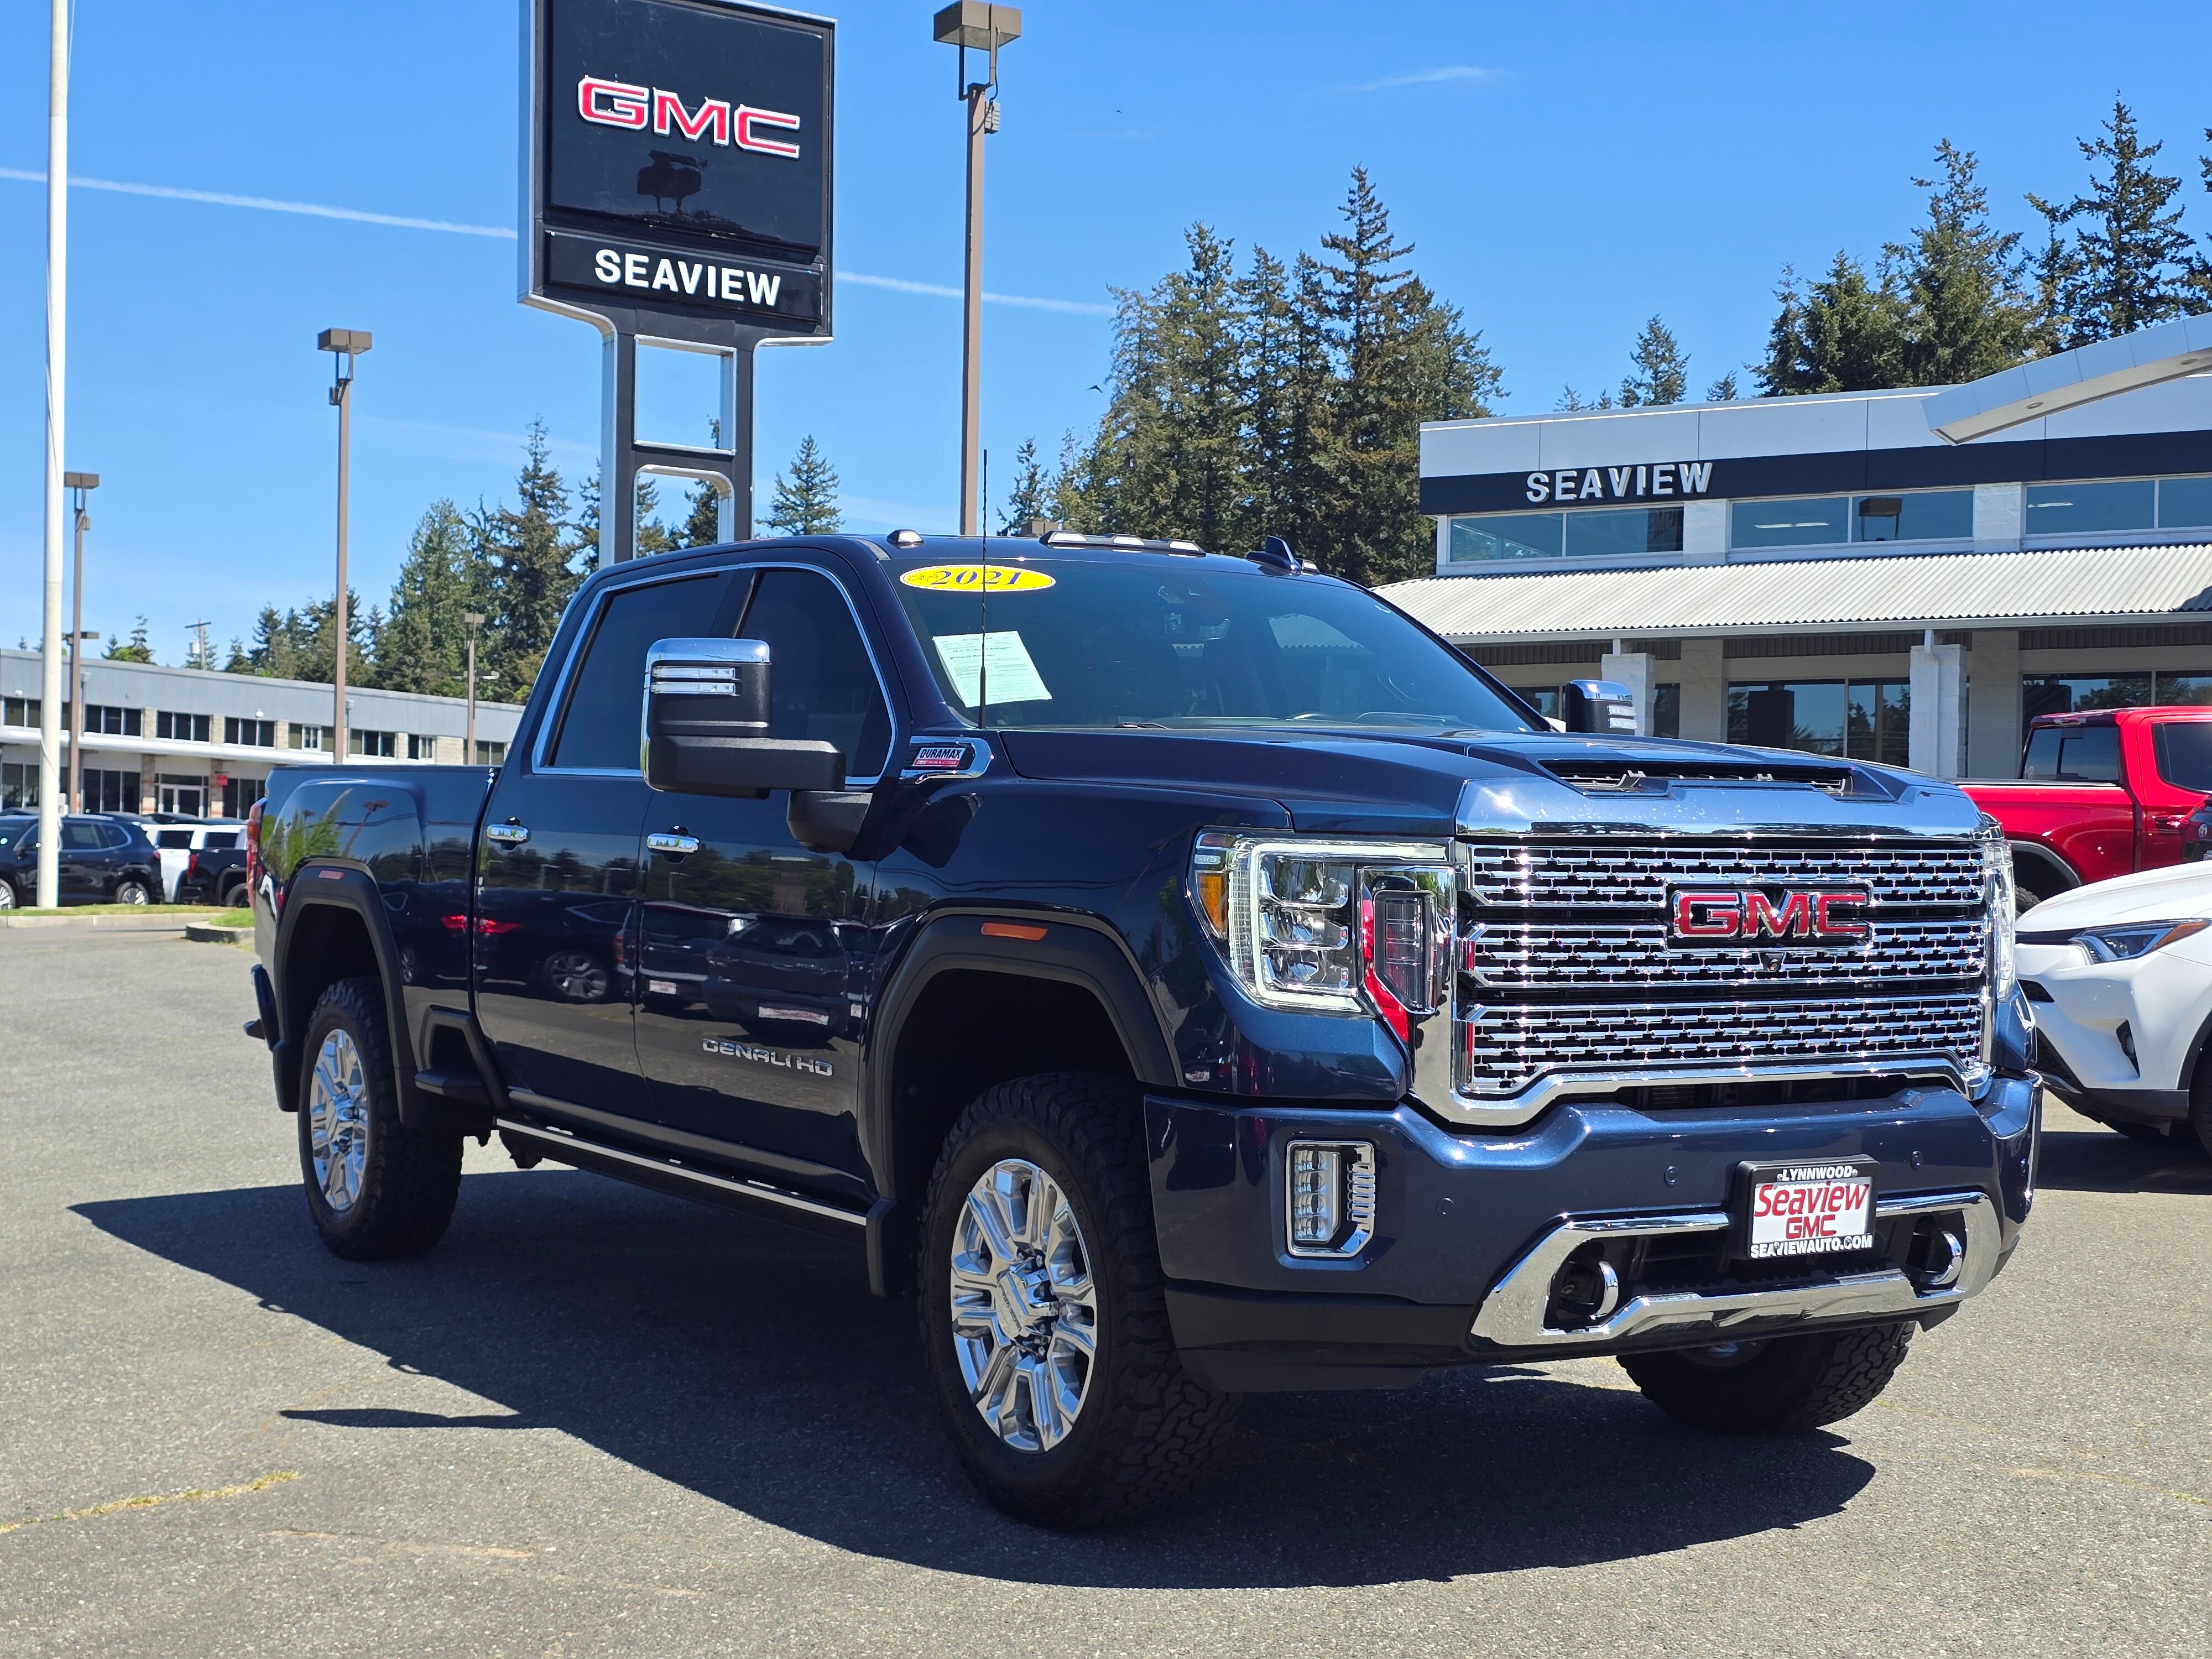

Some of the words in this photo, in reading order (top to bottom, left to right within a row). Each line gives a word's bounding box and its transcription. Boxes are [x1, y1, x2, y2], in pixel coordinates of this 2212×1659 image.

[578, 77, 800, 159] GMC
[595, 249, 781, 306] SEAVIEW
[1526, 462, 1713, 503] SEAVIEW
[930, 571, 1022, 585] 2021
[920, 749, 962, 759] DURAMAX
[1673, 889, 1867, 938] GMC
[703, 1038, 791, 1068] DENALI
[796, 1056, 832, 1076] HD
[1782, 1165, 1853, 1181] LYNNWOOD
[1754, 1181, 1870, 1217] Seaview
[1786, 1214, 1837, 1239] GMC
[1750, 1235, 1872, 1259] SEAVIEWAUTO.COM
